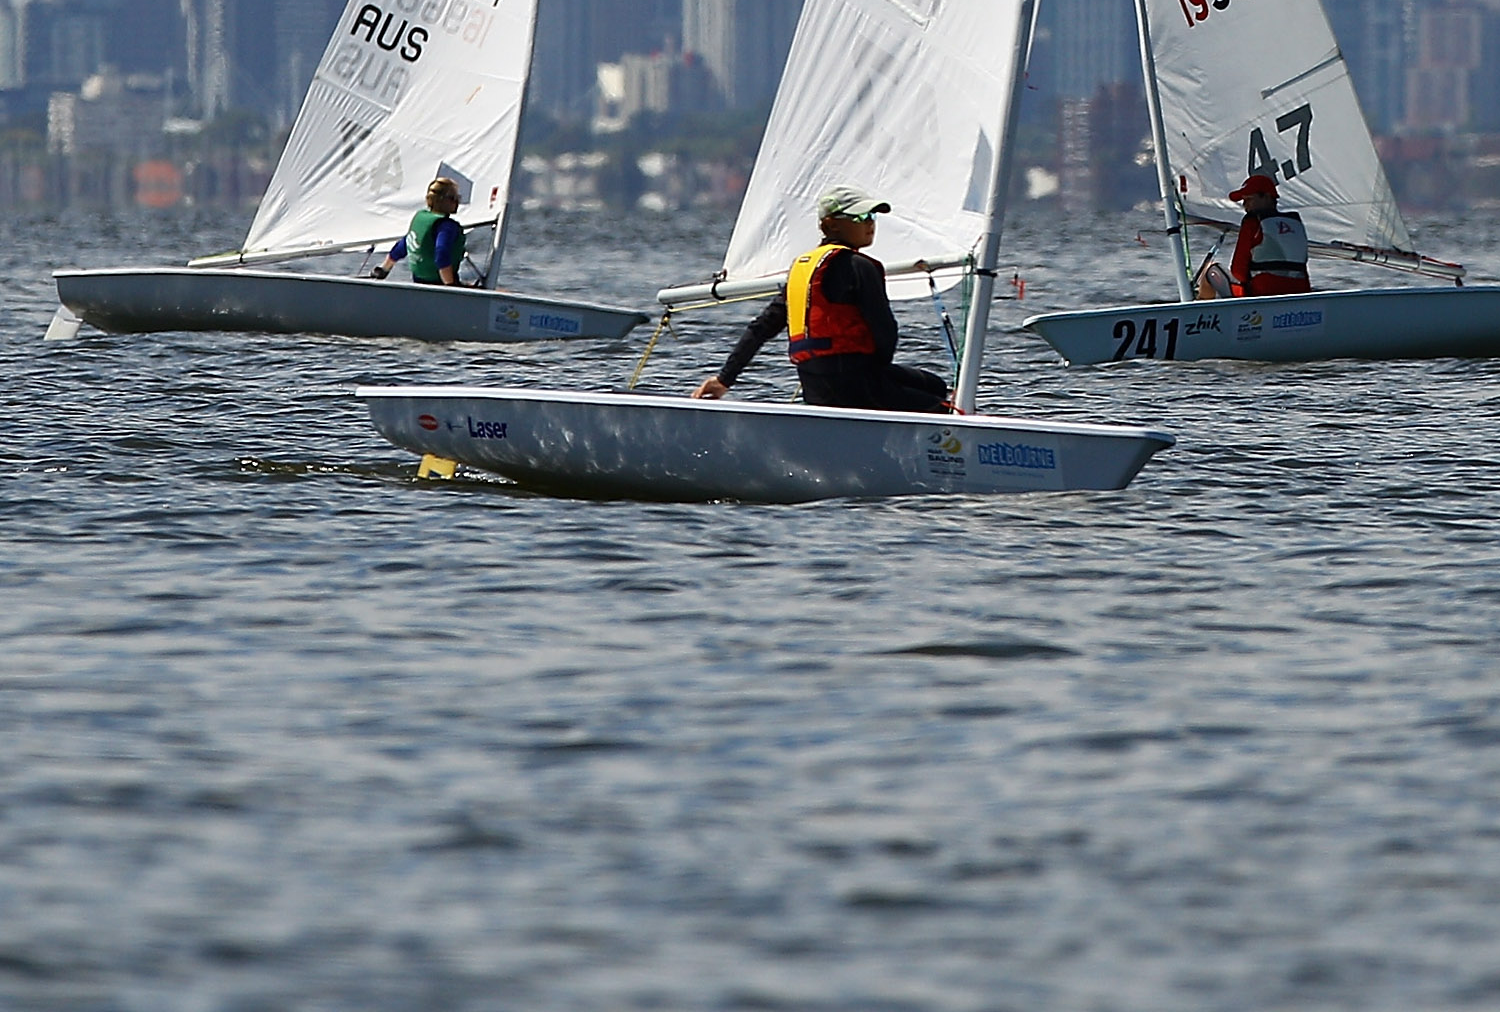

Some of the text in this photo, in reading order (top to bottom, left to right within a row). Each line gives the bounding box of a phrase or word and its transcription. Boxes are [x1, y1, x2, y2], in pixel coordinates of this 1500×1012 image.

[350, 4, 429, 63] AUS
[1247, 103, 1314, 186] 4.7
[1113, 318, 1180, 361] 241
[1184, 313, 1224, 336] zhik
[467, 415, 508, 439] Laser
[978, 443, 1056, 469] MELBOURNE
